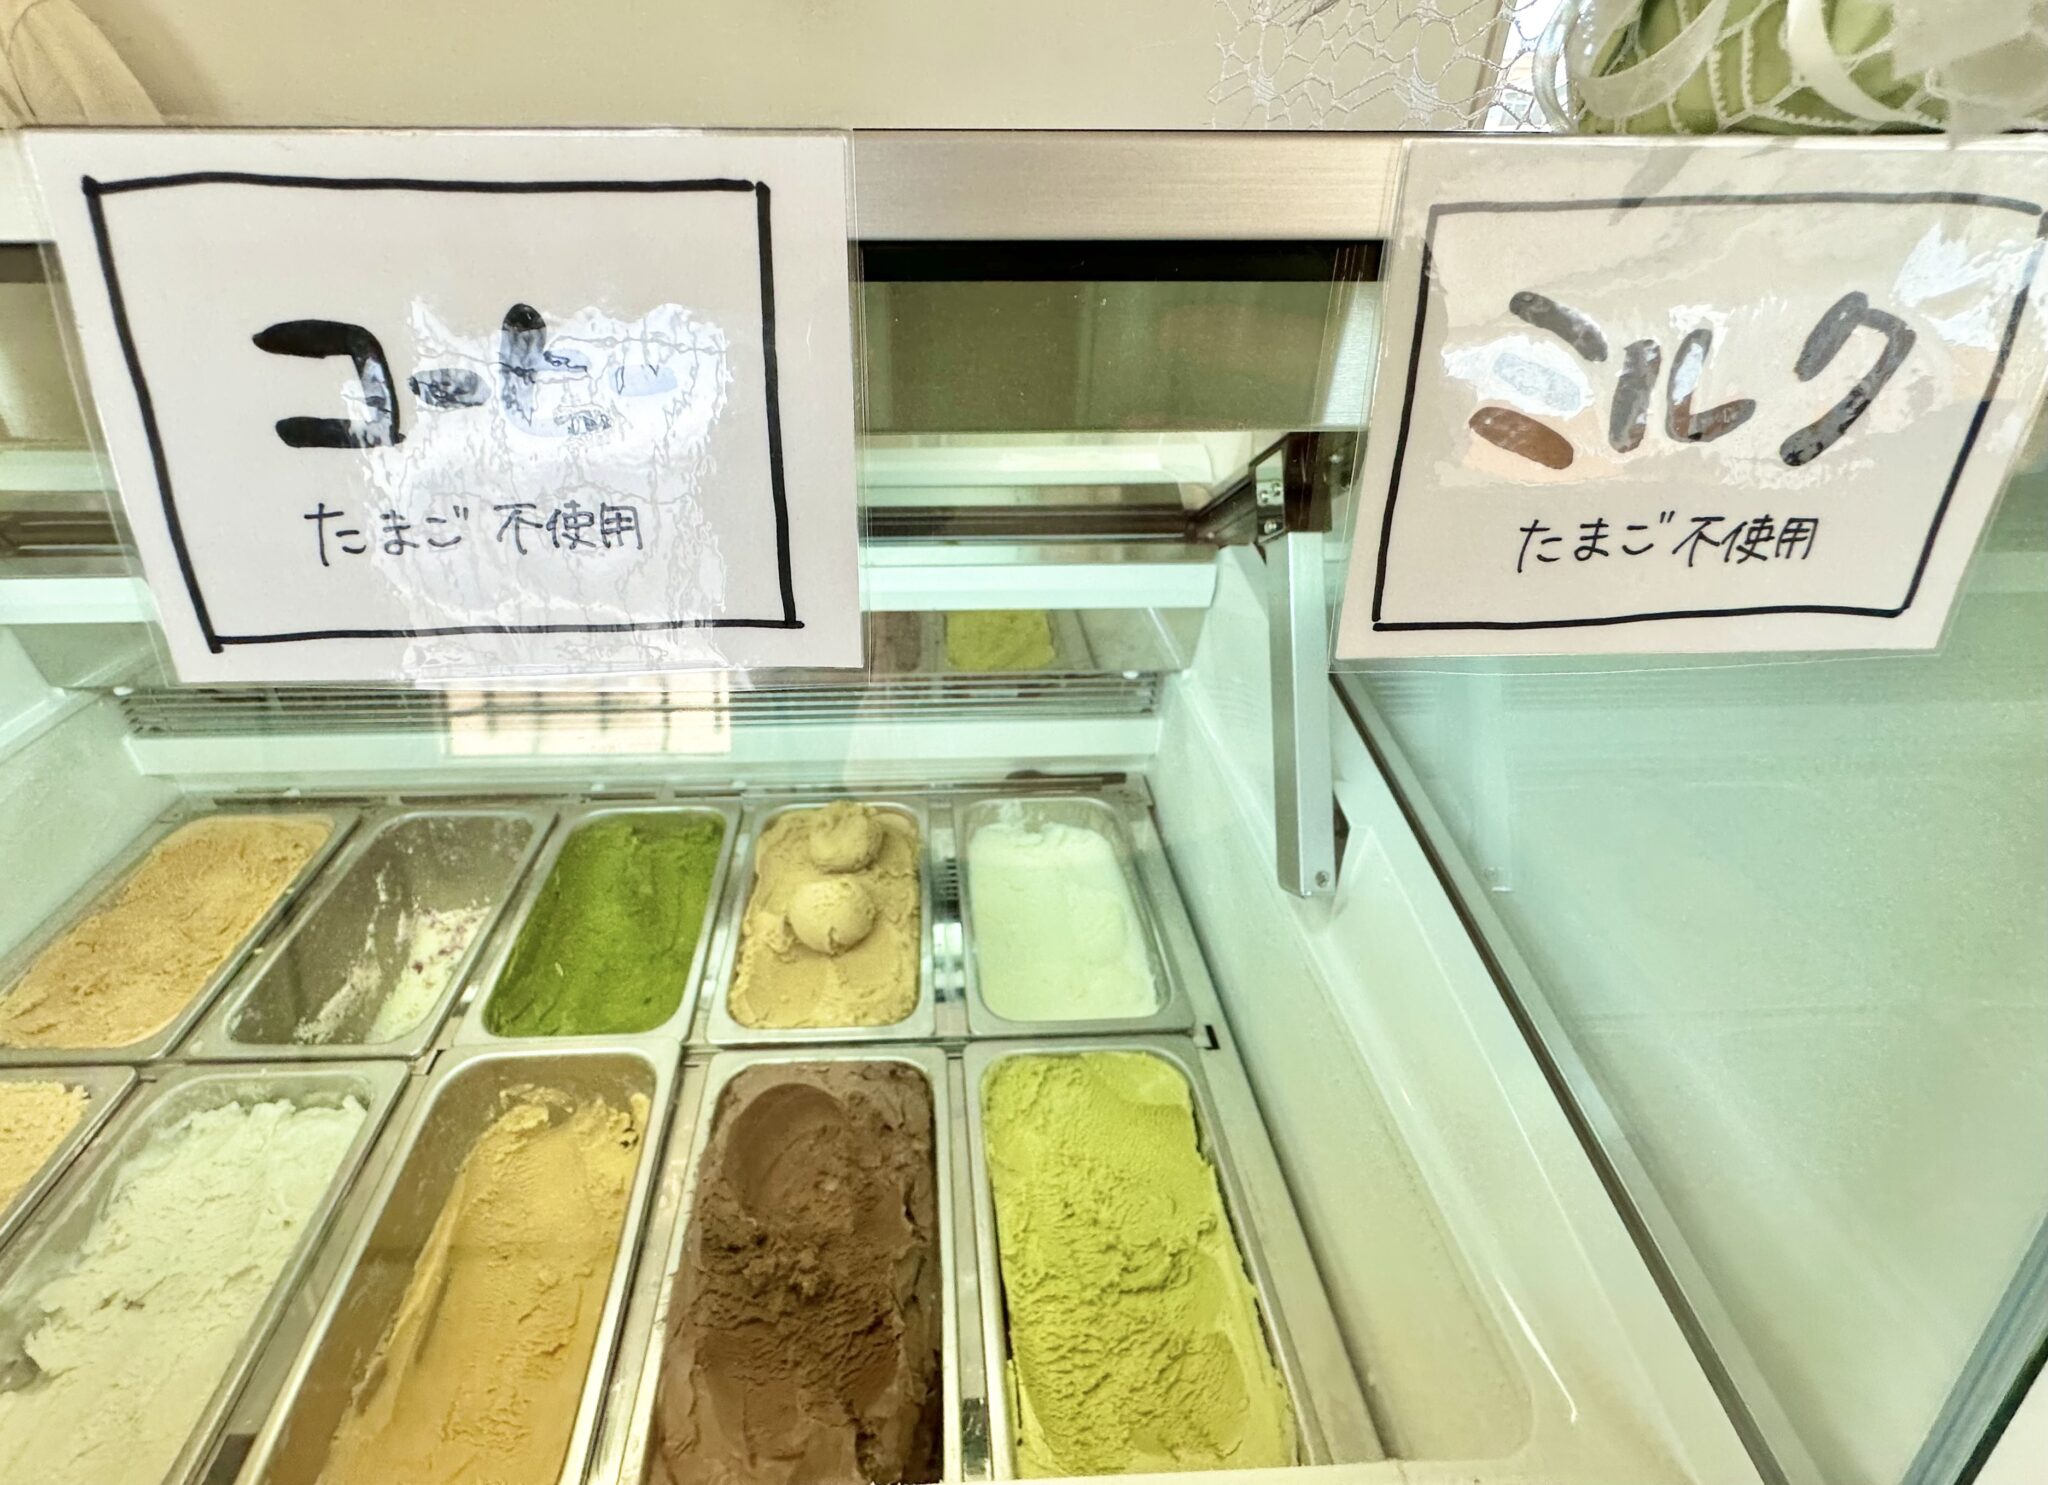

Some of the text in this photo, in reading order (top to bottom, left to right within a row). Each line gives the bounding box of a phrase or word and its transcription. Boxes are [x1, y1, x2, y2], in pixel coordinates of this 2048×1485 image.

[1468, 290, 1917, 470] ミルク
[1517, 510, 1819, 573] たまご不使用
